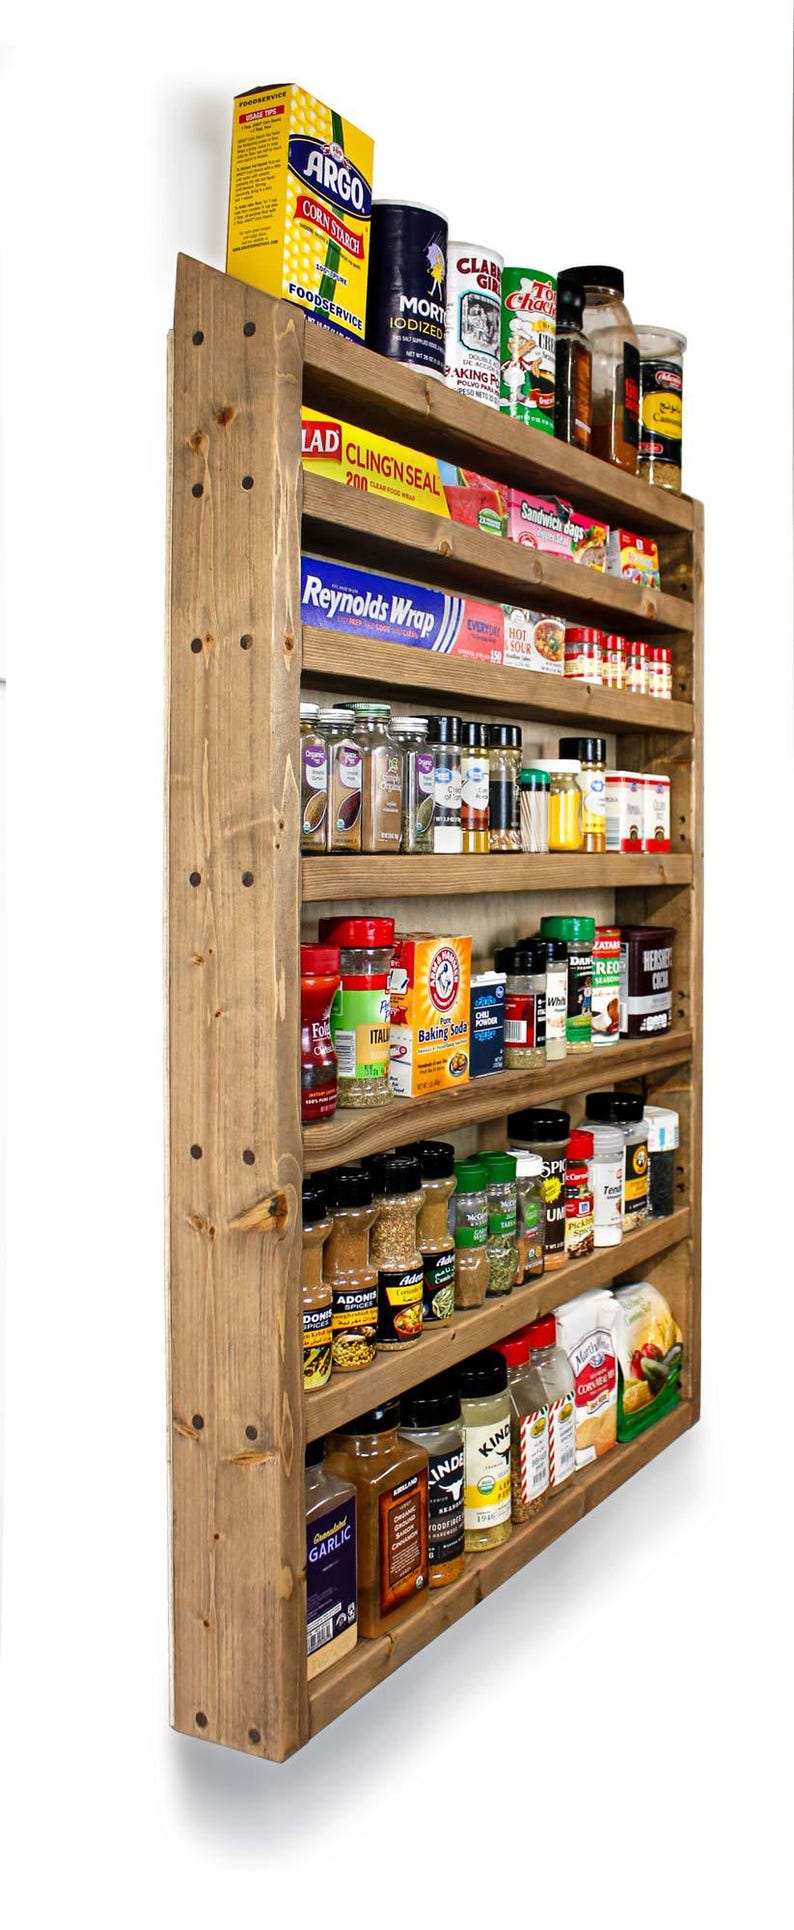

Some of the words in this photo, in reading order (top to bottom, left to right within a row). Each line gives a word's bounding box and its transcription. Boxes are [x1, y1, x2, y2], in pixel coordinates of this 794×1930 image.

[239, 91, 287, 108] FOODSERVICE
[246, 110, 263, 122] USAGE
[264, 107, 277, 117] TIPS
[303, 150, 364, 212] ARGO
[302, 199, 330, 231] CORN
[331, 219, 360, 255] STARCH
[288, 282, 363, 331] FOODSERVICE
[389, 315, 443, 340] IODIZED
[457, 379, 480, 389] POLVO
[346, 471, 368, 492] 200
[370, 480, 386, 492] CLEAR
[387, 486, 400, 497] FOOD
[402, 491, 416, 502] WRAP
[406, 464, 441, 497] SEAL
[521, 501, 563, 533] Sandwich
[563, 520, 584, 543] Bags
[302, 574, 389, 622] Reynolds
[389, 595, 435, 638] Wrap
[509, 627, 527, 641] HOT
[490, 649, 502, 660] 150
[510, 640, 532, 655] SOUR
[441, 950, 459, 984] HAMMER
[440, 1016, 452, 1025] Pure
[475, 1010, 490, 1019] CHILI
[475, 1016, 498, 1027] POWDER
[418, 1026, 448, 1043] Baking
[450, 1020, 467, 1036] Soda
[336, 1290, 377, 1305] ADONIS
[344, 1300, 373, 1311] SPICES
[303, 1308, 332, 1324] DONIS
[577, 1380, 595, 1395] CORN
[393, 1476, 418, 1497] KIRKLAND
[394, 1504, 417, 1524] ORGANIC
[394, 1514, 416, 1533] GROUND
[313, 1515, 347, 1545] Granulated
[309, 1525, 351, 1562] GARLIC
[391, 1530, 419, 1551] CINNAMON
